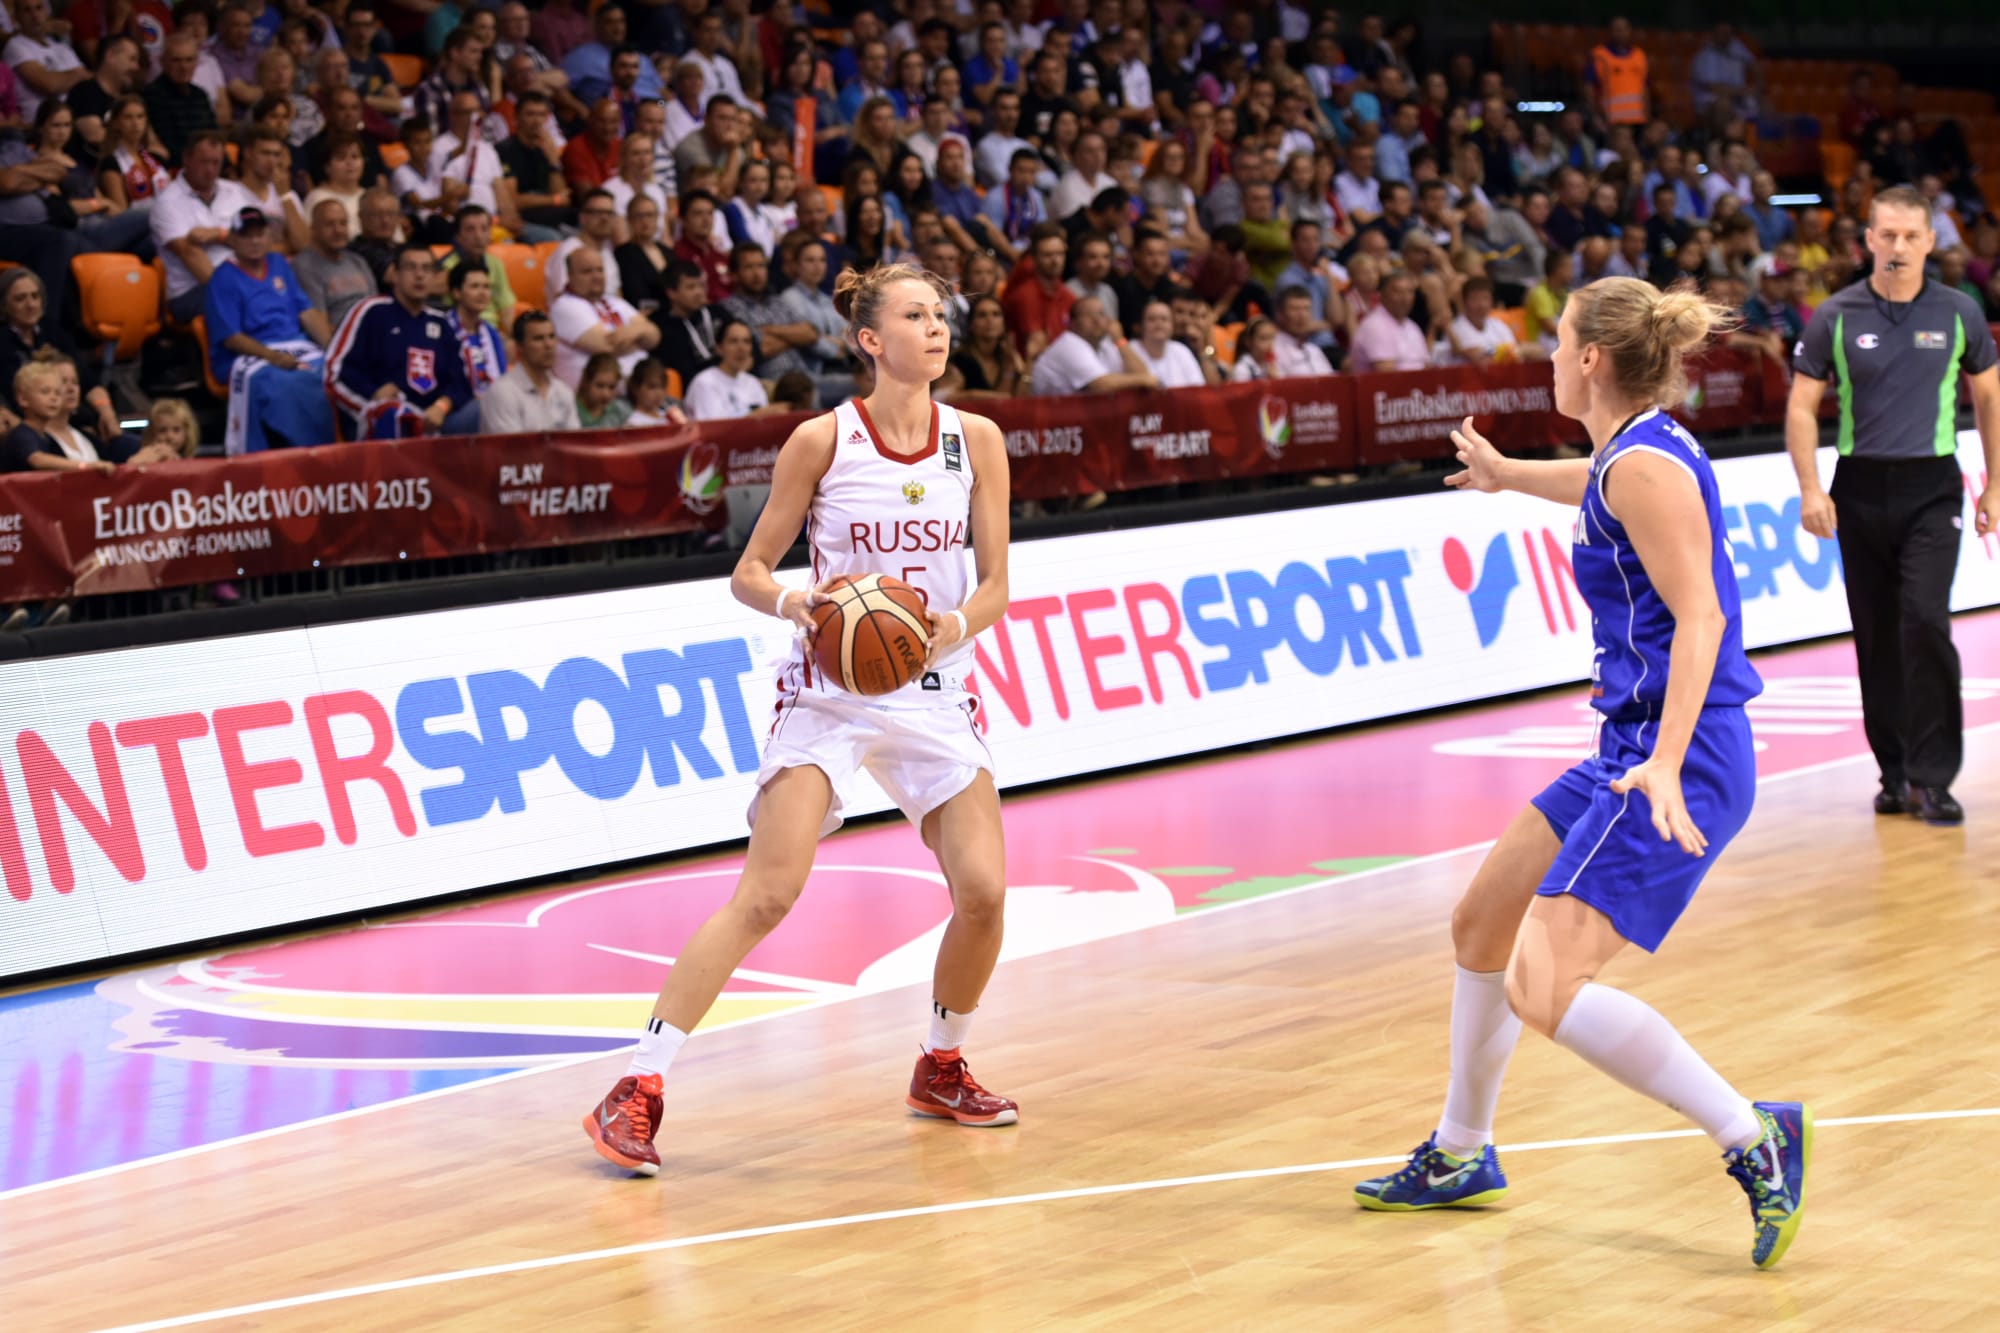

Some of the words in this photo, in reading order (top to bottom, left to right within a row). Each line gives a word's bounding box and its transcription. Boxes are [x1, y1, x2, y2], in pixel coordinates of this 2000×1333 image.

[1129, 413, 1163, 434] PLAY
[1041, 426, 1083, 456] 2015
[1153, 430, 1212, 459] HEART
[499, 463, 543, 486] PLAY
[373, 477, 432, 512] 2015
[530, 483, 613, 517] HEART
[850, 519, 964, 554] RUSSIA
[901, 566, 929, 605] 5
